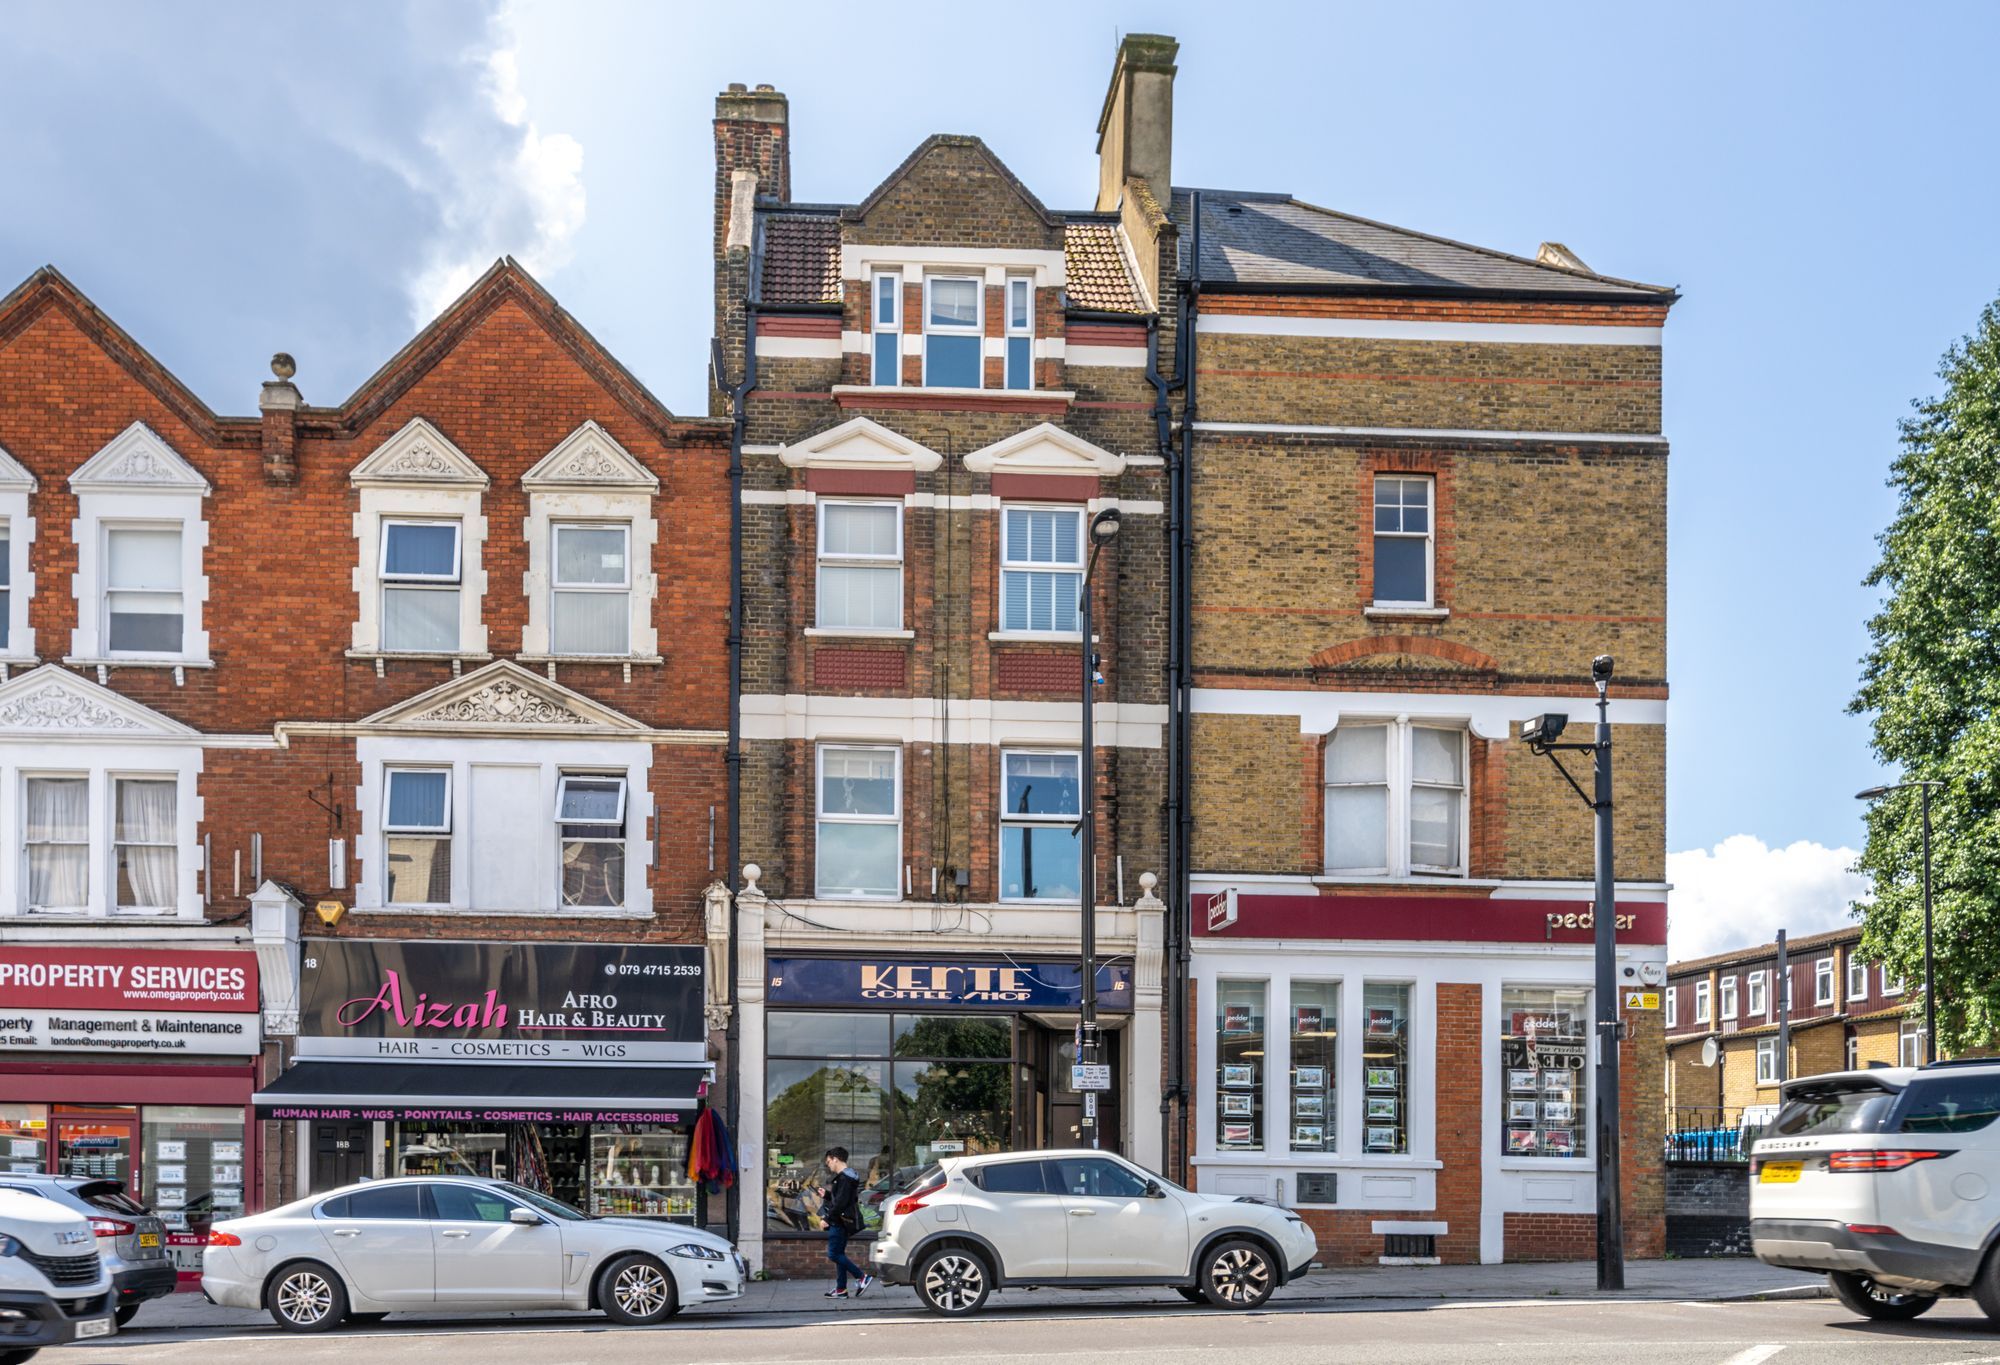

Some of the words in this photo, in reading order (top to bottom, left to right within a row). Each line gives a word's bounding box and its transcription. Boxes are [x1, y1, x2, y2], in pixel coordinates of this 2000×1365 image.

[1546, 902, 1636, 939] peder
[304, 958, 317, 968] 18
[619, 964, 640, 975] 079
[642, 965, 671, 975] 4715
[673, 965, 701, 976] 2539
[0, 963, 124, 988] PROPERTY
[130, 965, 245, 990] SERVICES
[771, 977, 783, 987] 16
[1113, 981, 1125, 991] 16
[123, 990, 245, 1002] www.omegaproperty.co.uk
[336, 968, 509, 1029] Aizah
[561, 990, 618, 1009] AFRO
[861, 990, 953, 999] COFFEE
[958, 991, 1031, 1001] SHOP
[518, 1009, 567, 1027] HAIR
[571, 1012, 586, 1027] &
[591, 1011, 666, 1028] BEAUTY
[1227, 1015, 1249, 1023] pedder
[1299, 1016, 1321, 1024] pedder
[1371, 1017, 1393, 1025] pedder
[48, 1016, 138, 1034] Management
[141, 1018, 151, 1032] &
[156, 1018, 243, 1034] Maintenance
[50, 1036, 186, 1050] london@omegaproperty.co.uk
[378, 1041, 420, 1054] HAIR
[451, 1042, 551, 1057] COSMETICS
[581, 1044, 627, 1057] WIGS
[272, 1108, 318, 1118] HUMAN
[321, 1109, 351, 1119] HAIR
[361, 1110, 394, 1119] WIGS
[404, 1110, 473, 1120] PONYTAILS
[483, 1111, 553, 1121] COSMETICS
[563, 1112, 593, 1121] HAIR
[596, 1112, 680, 1123] ACCESSORIES
[336, 1140, 350, 1149] 18B
